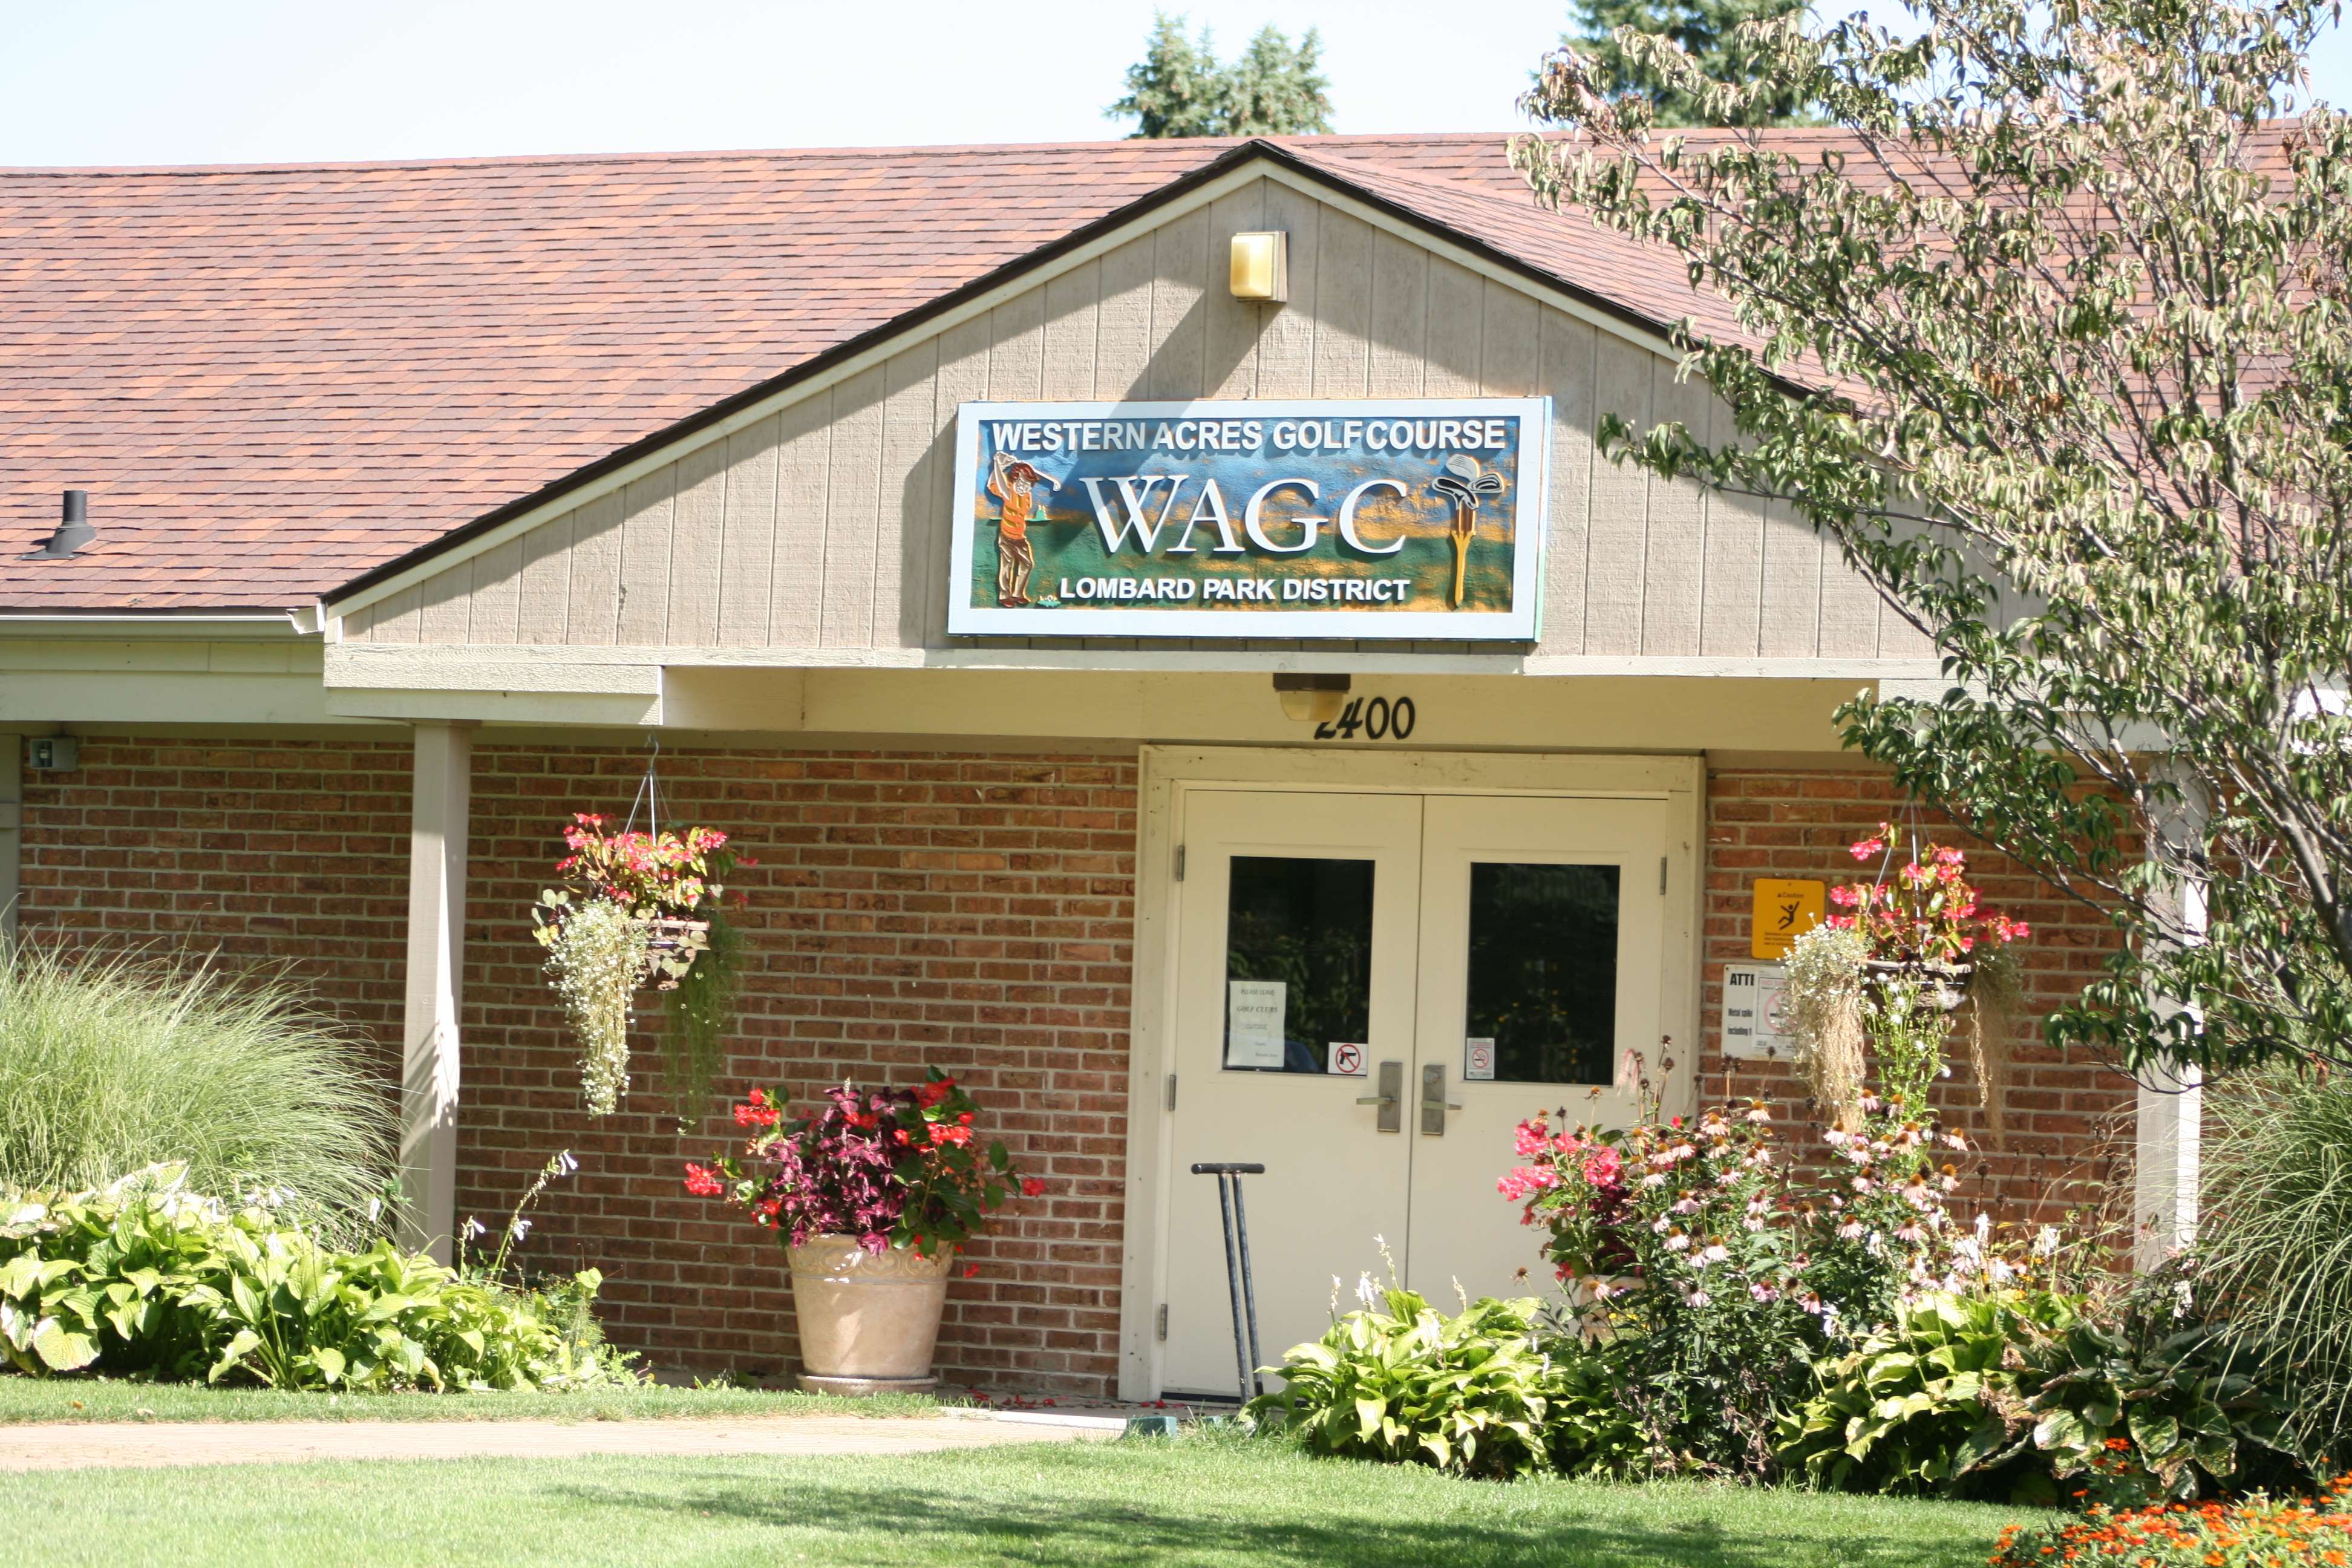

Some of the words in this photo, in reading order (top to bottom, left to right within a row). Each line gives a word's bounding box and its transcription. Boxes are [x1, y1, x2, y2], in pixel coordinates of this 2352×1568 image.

[991, 422, 1146, 451] WESTERN
[1151, 420, 1263, 451] ACRES
[1272, 420, 1362, 450] GOLF
[1365, 419, 1506, 449] COURSE
[1079, 474, 1408, 554] WAGC
[1060, 577, 1196, 599] LOMBARD
[1202, 578, 1277, 600] PARK
[1282, 578, 1411, 601] DISTRICT
